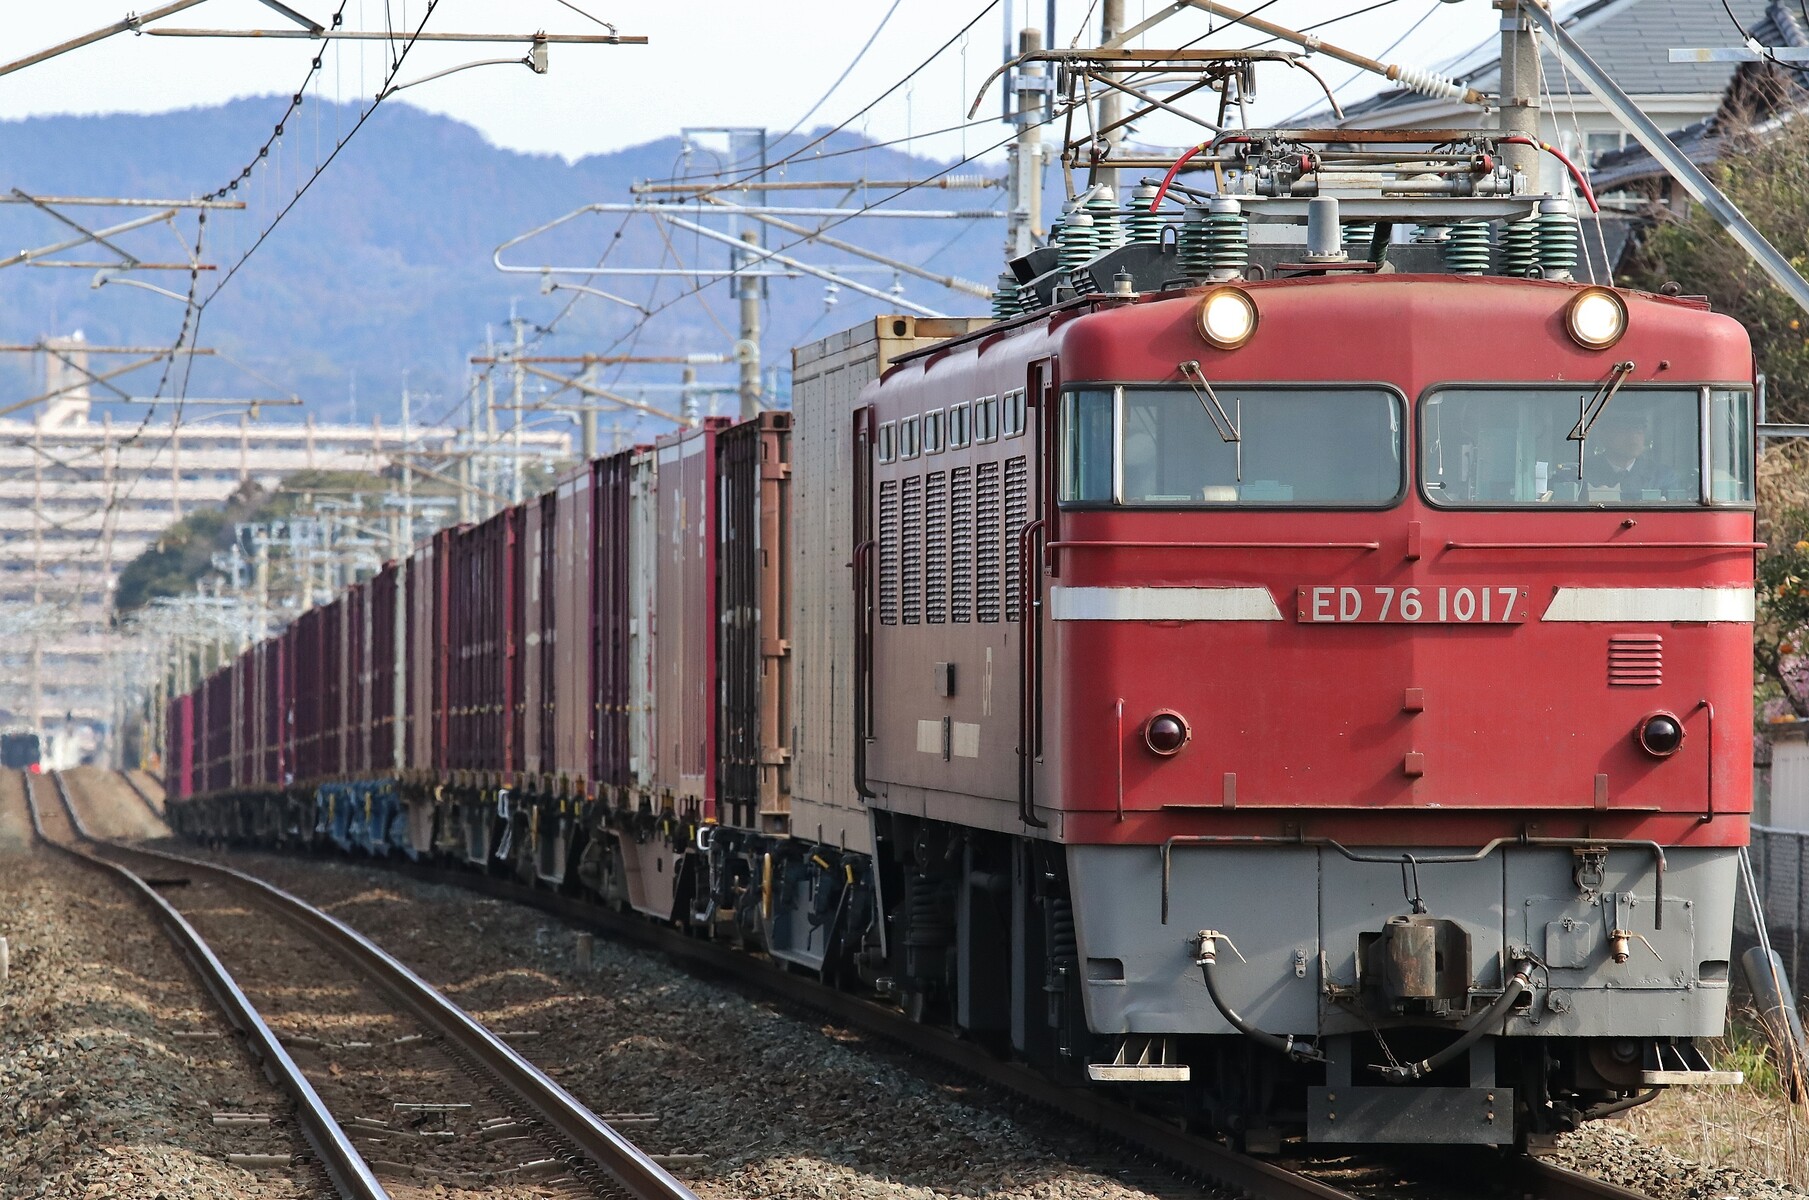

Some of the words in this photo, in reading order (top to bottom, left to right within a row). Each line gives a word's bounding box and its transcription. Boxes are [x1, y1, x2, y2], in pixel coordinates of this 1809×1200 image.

[1312, 587, 1362, 621] ED
[1374, 587, 1423, 621] 76
[1439, 587, 1518, 621] 1017
